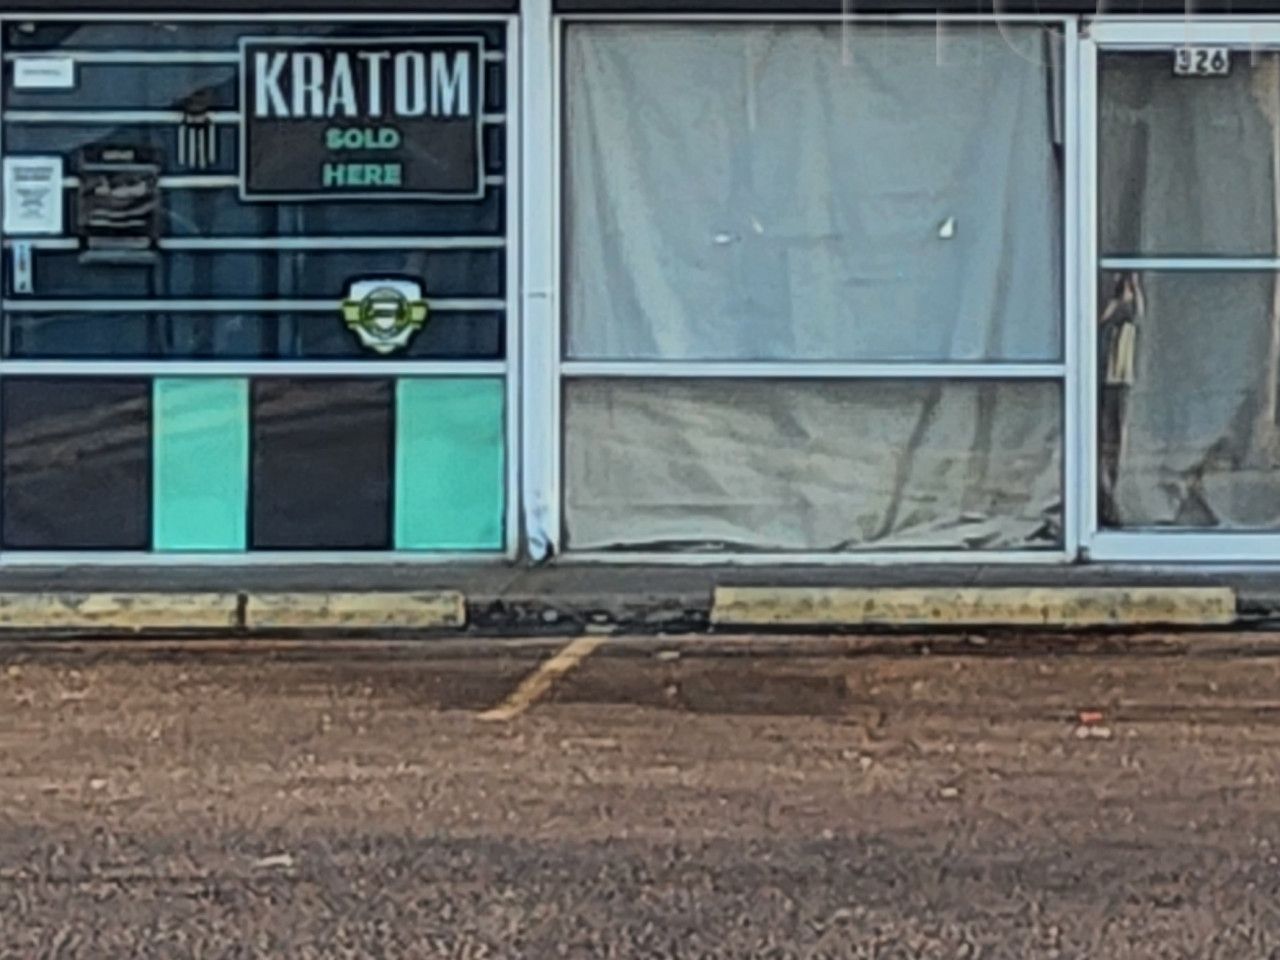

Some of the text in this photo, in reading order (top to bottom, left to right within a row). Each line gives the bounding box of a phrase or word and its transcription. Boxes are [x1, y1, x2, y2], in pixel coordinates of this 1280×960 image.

[1179, 49, 1226, 73] 326
[255, 50, 471, 117] KRATOM
[325, 128, 400, 149] SOLD
[323, 164, 402, 187] HERE
